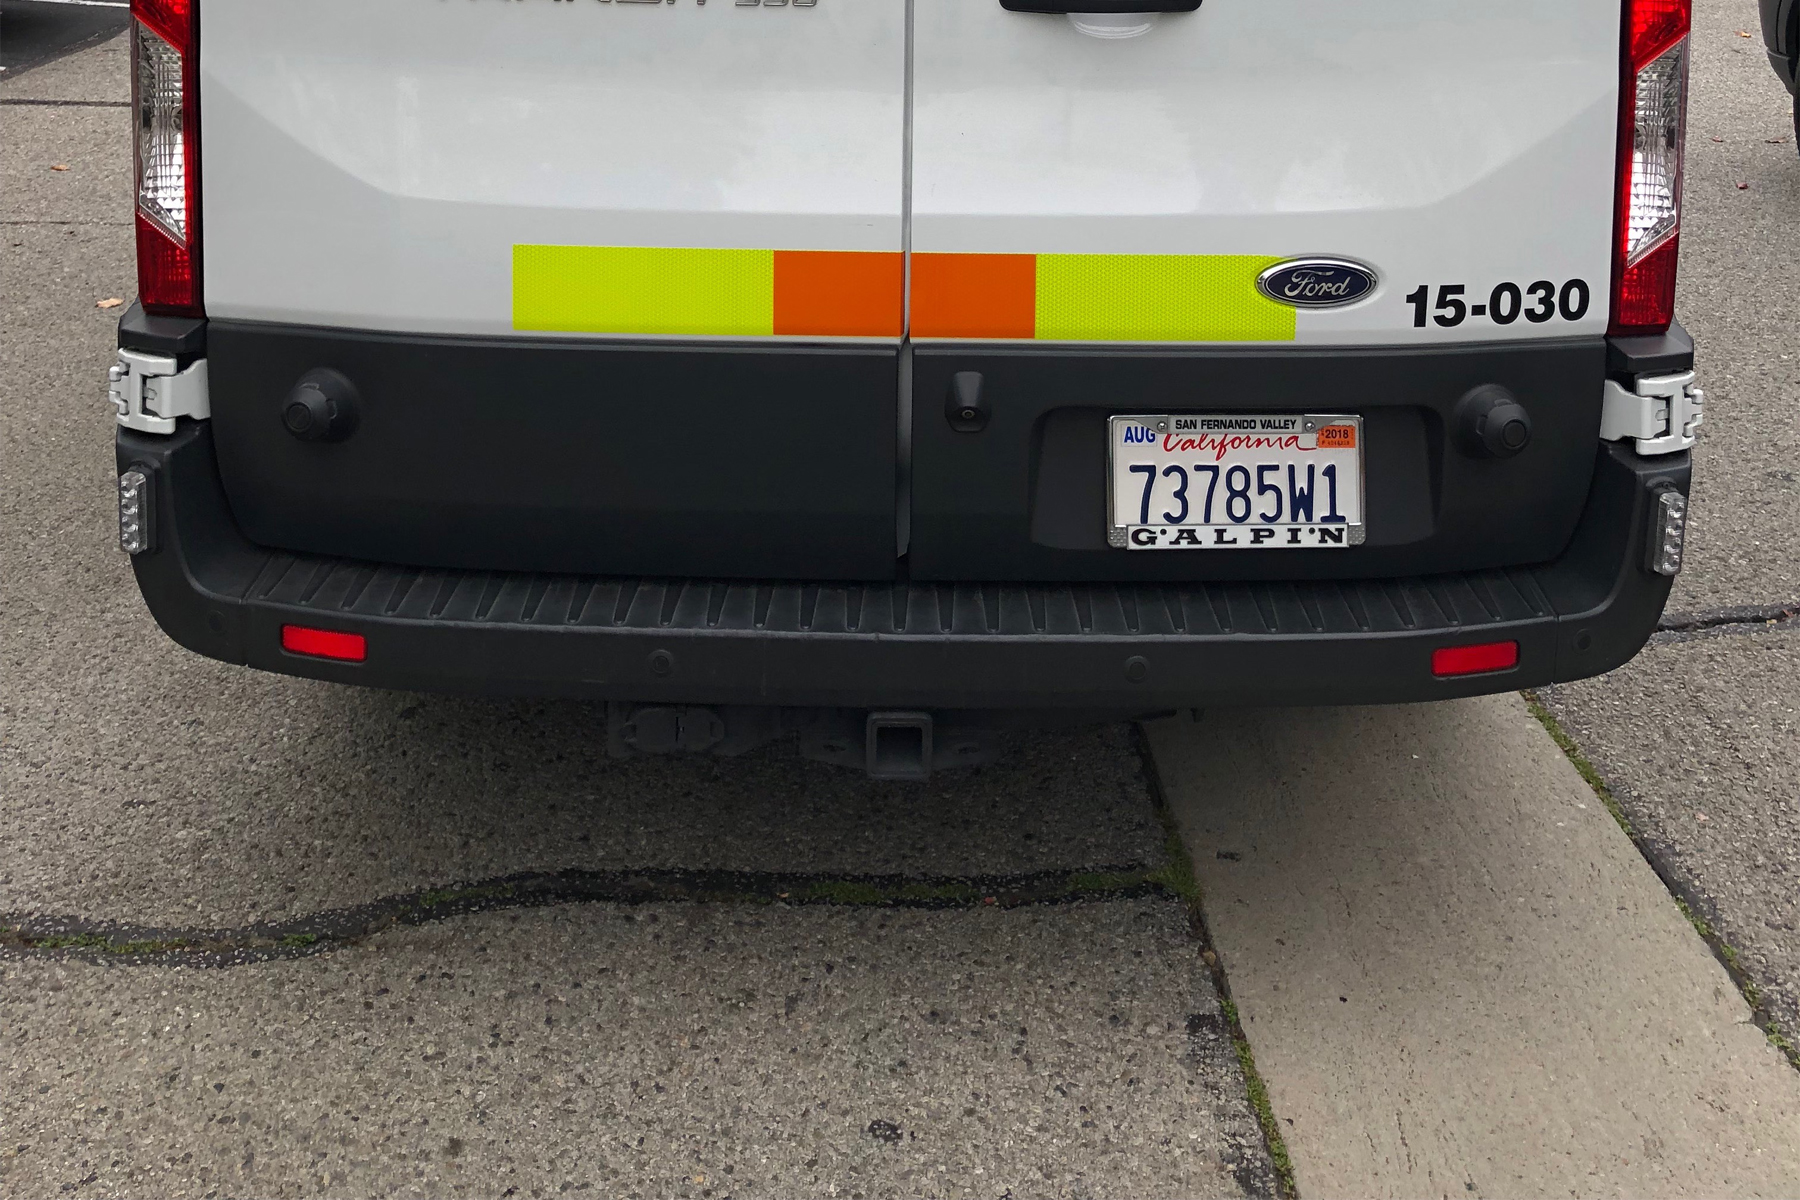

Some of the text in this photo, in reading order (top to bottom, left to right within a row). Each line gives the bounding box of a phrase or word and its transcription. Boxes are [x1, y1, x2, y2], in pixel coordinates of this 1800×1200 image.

[1284, 270, 1351, 297] Ford
[1405, 278, 1591, 328] 15-030
[1124, 426, 1156, 443] AUG
[1175, 419, 1297, 430] SAN FERNANDO VALLEY
[1325, 429, 1349, 439] 2018
[1162, 433, 1317, 461] California
[1129, 463, 1346, 525] 73785W1
[1131, 527, 1345, 546] GALPIN
